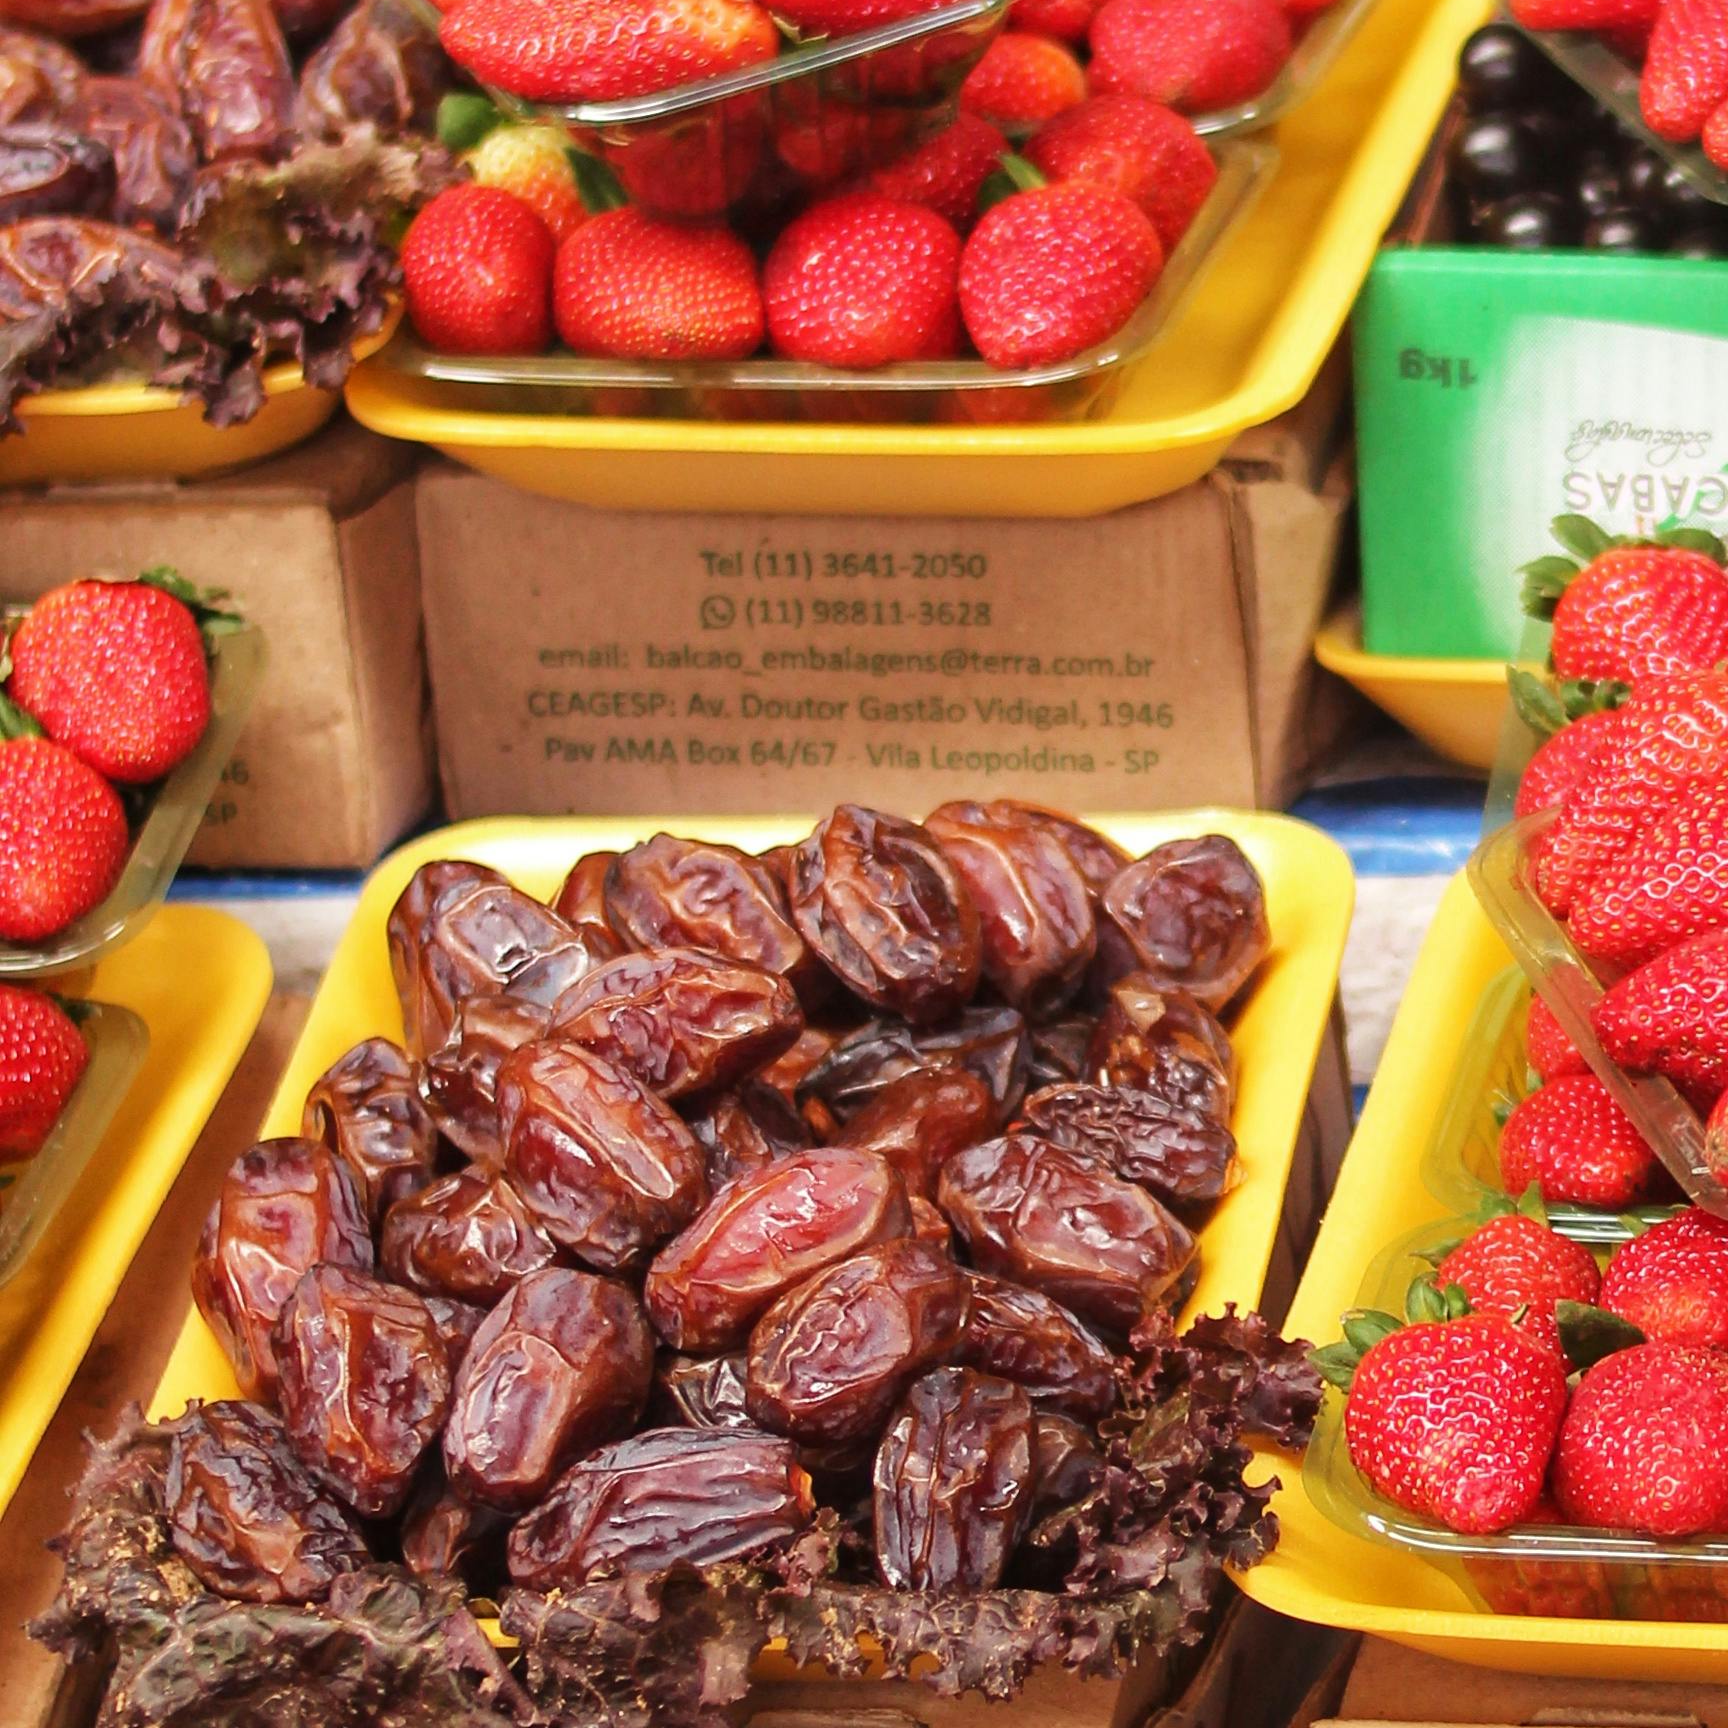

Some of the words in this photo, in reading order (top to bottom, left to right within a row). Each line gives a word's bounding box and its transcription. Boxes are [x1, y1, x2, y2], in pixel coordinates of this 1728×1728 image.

[1399, 348, 1477, 389] 1kg
[700, 550, 743, 577] Tel
[753, 549, 813, 580] (11)
[823, 552, 987, 579] 3641-2050
[746, 597, 802, 628] (11)
[813, 598, 992, 626] 98811-3628
[539, 644, 628, 670] email:
[647, 644, 1155, 677] balcao_embalagens@terra.com.br
[528, 691, 676, 719] CEAGESP:
[687, 692, 731, 719] Av.
[742, 693, 848, 721] Doutor
[859, 696, 966, 725] Gastão
[974, 699, 1088, 730] Vidigal,
[1100, 702, 1174, 729] 1946
[545, 738, 594, 763] Pav
[605, 738, 678, 765] AMA
[688, 739, 740, 765] Box
[750, 738, 836, 768] 64/67
[866, 743, 920, 769] Vila
[931, 745, 1095, 774] Leopoldina
[1124, 747, 1160, 774] SP
